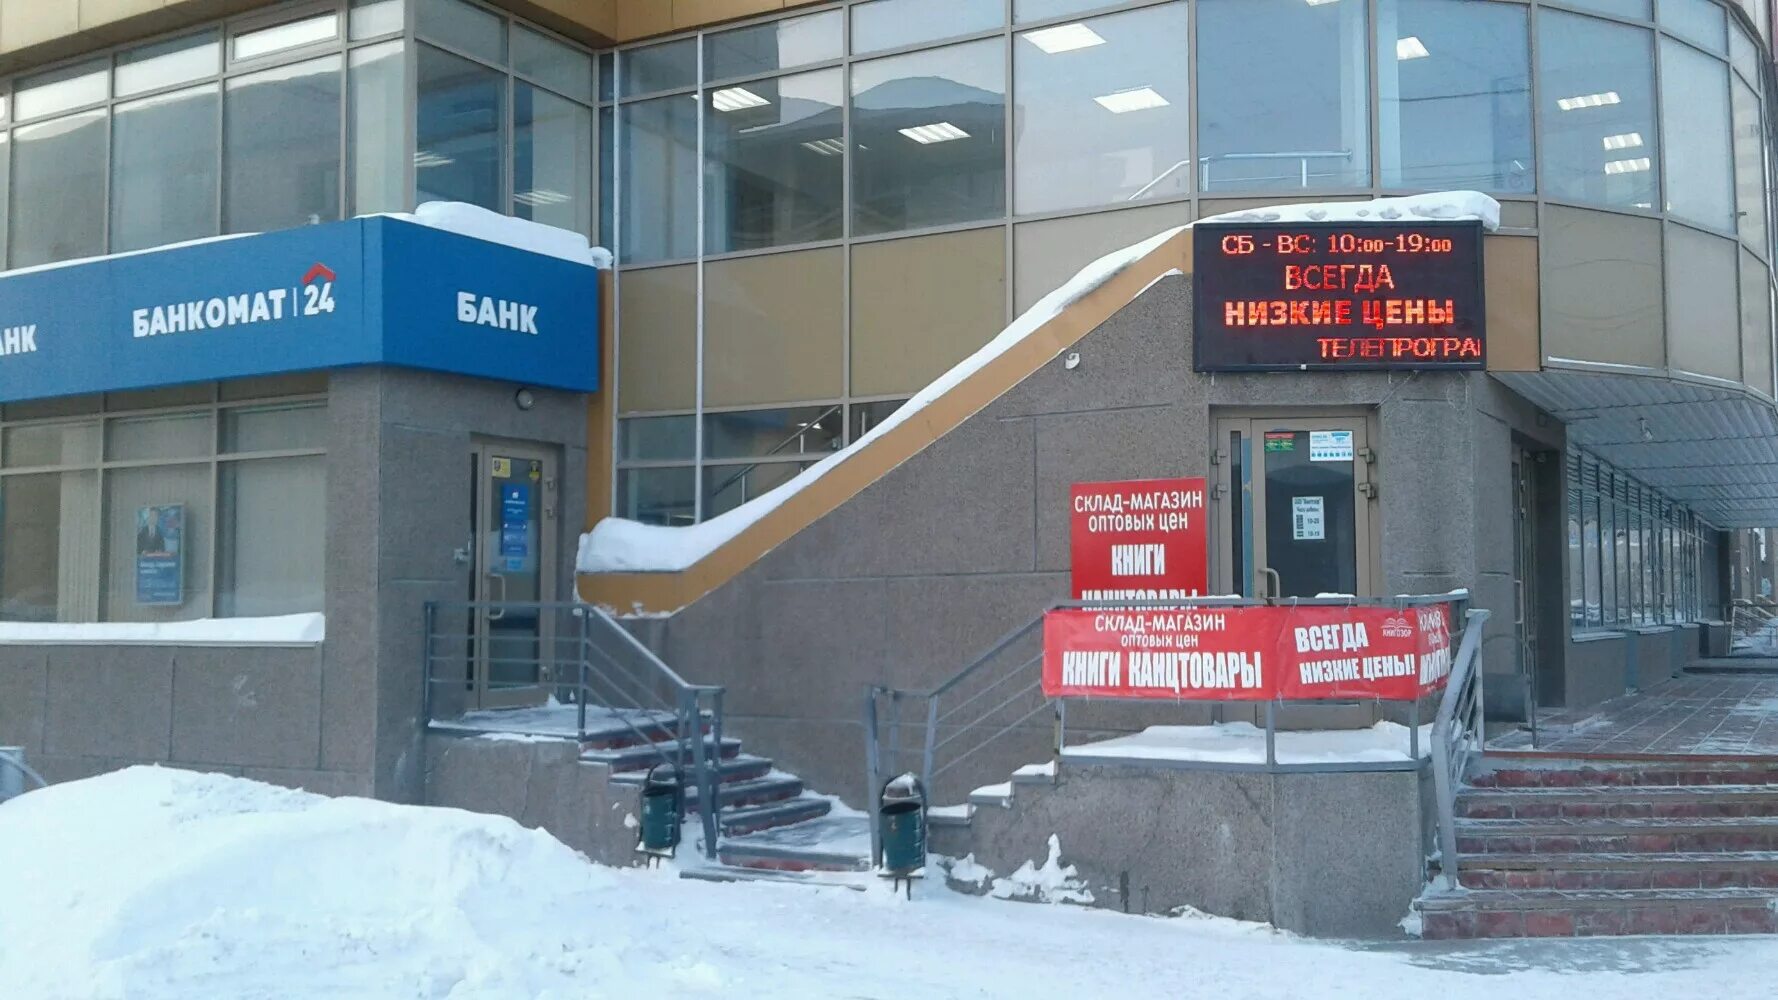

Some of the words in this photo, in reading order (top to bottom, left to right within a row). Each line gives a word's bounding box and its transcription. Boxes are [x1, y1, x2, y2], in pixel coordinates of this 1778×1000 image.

[1221, 234, 1255, 254] СБ
[1328, 233, 1452, 253] 10:00-19:00
[1285, 264, 1395, 293] ВСЕГДА
[132, 288, 287, 338] БАНКОМАТ
[303, 281, 335, 316] 24
[457, 291, 539, 335] БАНК
[1224, 300, 1352, 326] НИЗКИЕ
[1362, 299, 1455, 330] ЦЕНЫ
[1316, 337, 1481, 358] ТЕЛЕПРОГРА
[1074, 490, 1203, 513] СКЛАД-МАГАЗИН
[1111, 543, 1165, 576] КНИГИ
[1094, 613, 1226, 635] СКЛАД-МАГАЗИН
[1294, 622, 1369, 653] ВСЕГДА
[1062, 651, 1121, 687] КНИГИ
[1128, 651, 1262, 693] КАНЦТОВАРЫ
[1299, 658, 1361, 685] НИЗКИЕ
[1362, 653, 1416, 682] ЦЕНЫ!
